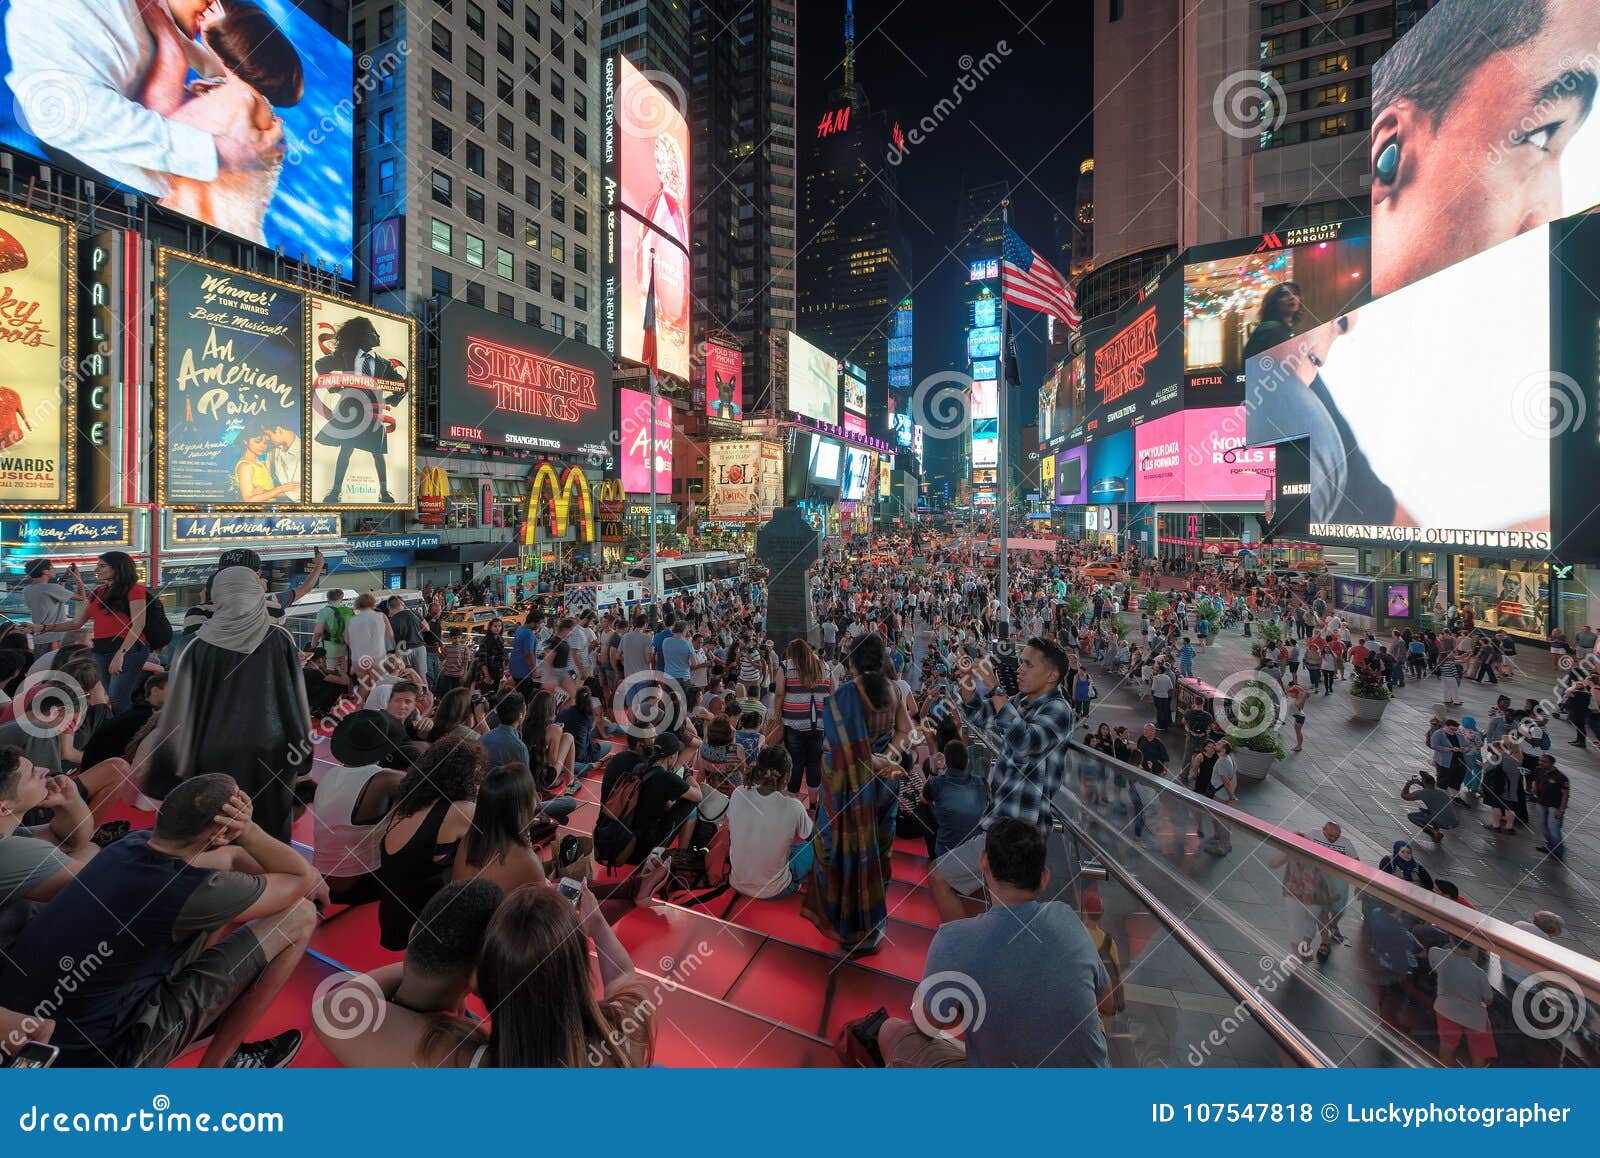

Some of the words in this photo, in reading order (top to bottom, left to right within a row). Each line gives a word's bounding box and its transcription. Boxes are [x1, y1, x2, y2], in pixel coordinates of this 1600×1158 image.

[605, 57, 614, 103] AGRANCE
[605, 104, 614, 125] FOR
[817, 106, 851, 138] H&M
[605, 126, 614, 163] WOMEN
[1287, 223, 1343, 237] MARRIOTT
[1287, 231, 1337, 245] MARQUIS
[200, 273, 278, 307] Winner!
[606, 276, 614, 294] THE
[218, 297, 238, 309] TONY
[606, 295, 614, 320] NEW
[188, 306, 229, 324] Best
[231, 315, 288, 336] Musical!
[202, 326, 235, 362] An
[712, 346, 727, 358] HOLD
[728, 351, 739, 361] THE
[1095, 308, 1158, 391] STRANGER
[716, 354, 736, 366] PHONE
[175, 348, 295, 409] American
[318, 376, 340, 386] FINAL
[342, 376, 375, 388] MONTHS
[467, 338, 597, 410] STRANGER
[1191, 376, 1223, 387] NETFLIX
[493, 381, 581, 423] THINGS
[451, 426, 482, 440] NETFLIX
[505, 434, 538, 447] STRANGER
[538, 438, 561, 449] THINGS
[0, 457, 54, 472] WARDS
[186, 520, 206, 537] An
[209, 518, 272, 538] American
[276, 518, 306, 535] Paris
[1311, 524, 1372, 539] AMERICAN
[1376, 525, 1421, 541] EAGLE
[1425, 527, 1550, 550] OUTFITTERS
[384, 538, 416, 548] MONEY
[420, 538, 438, 546] ATM
